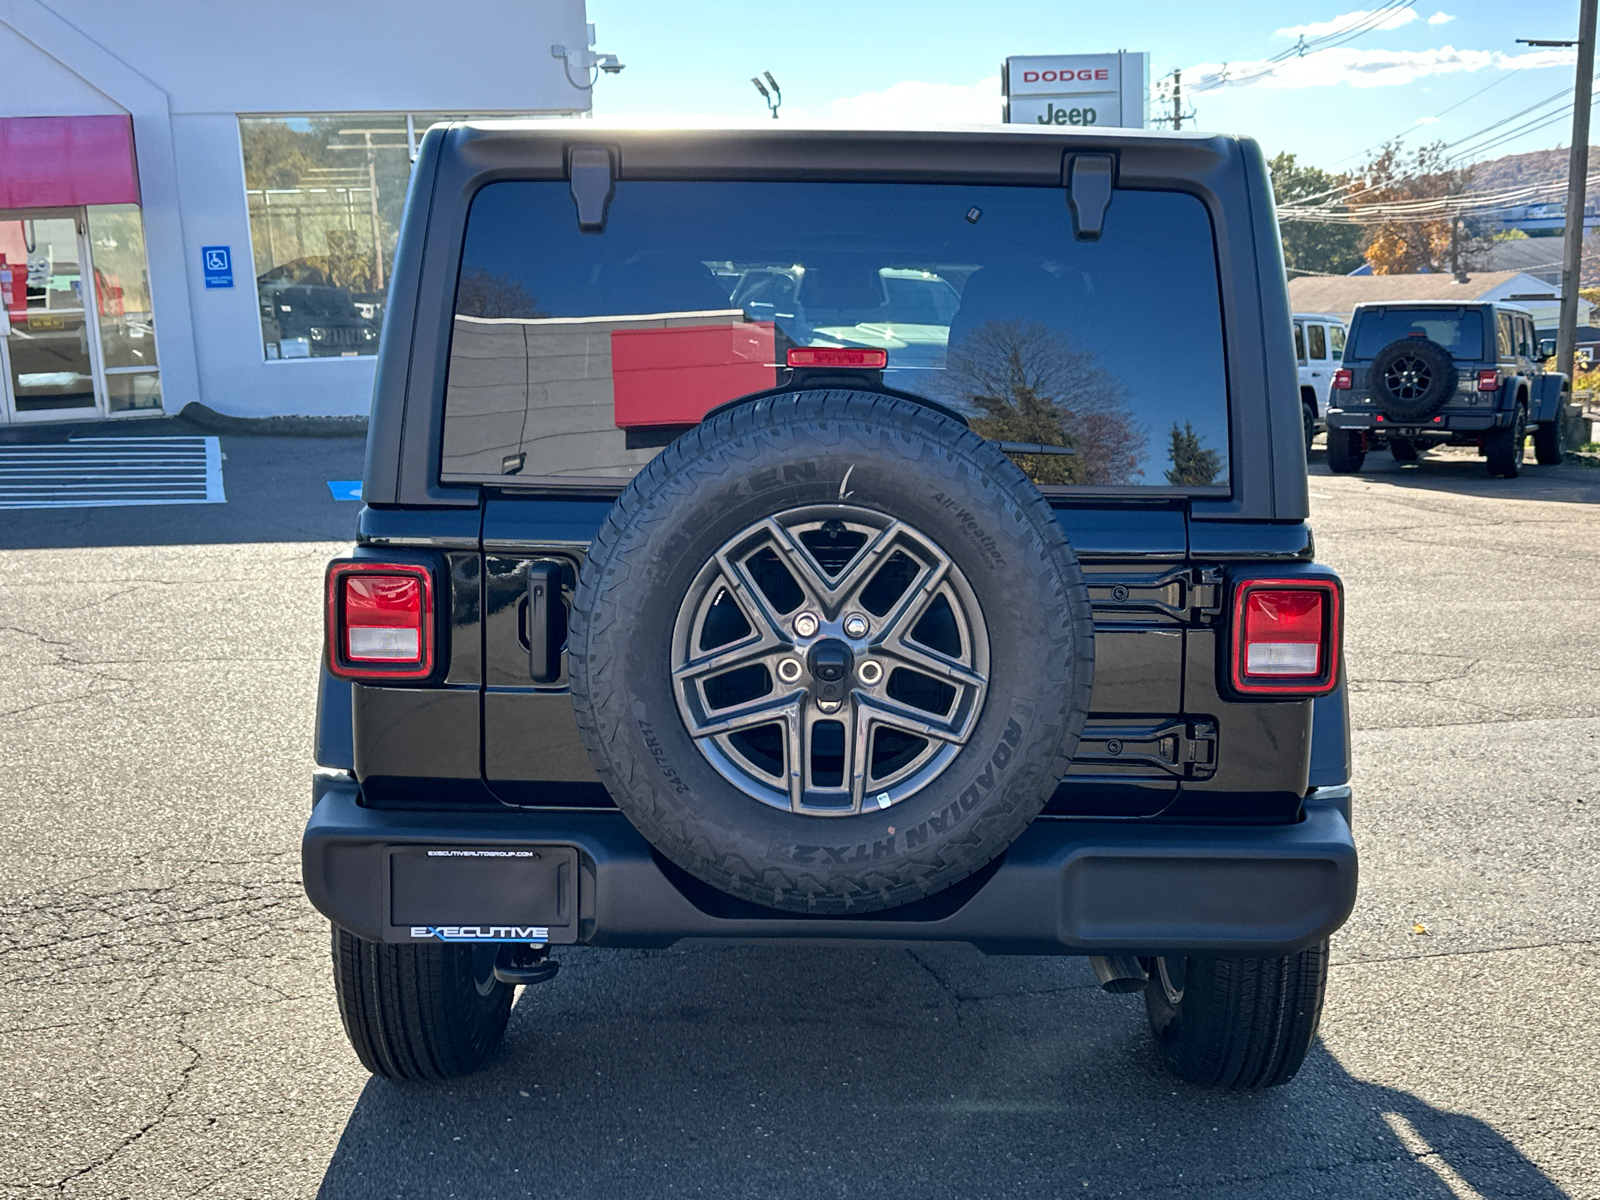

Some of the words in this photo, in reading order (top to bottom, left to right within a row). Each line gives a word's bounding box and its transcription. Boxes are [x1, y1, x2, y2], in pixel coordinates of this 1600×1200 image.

[1023, 69, 1109, 83] DODGE
[1037, 103, 1097, 126] Jeep
[660, 461, 817, 564] NEXEN
[931, 492, 1007, 566] All-Weather
[637, 719, 692, 795] 245/75R17
[905, 716, 1024, 850] ROADIAN
[792, 835, 897, 865] HTX2
[410, 926, 549, 941] EXECUTIVE
